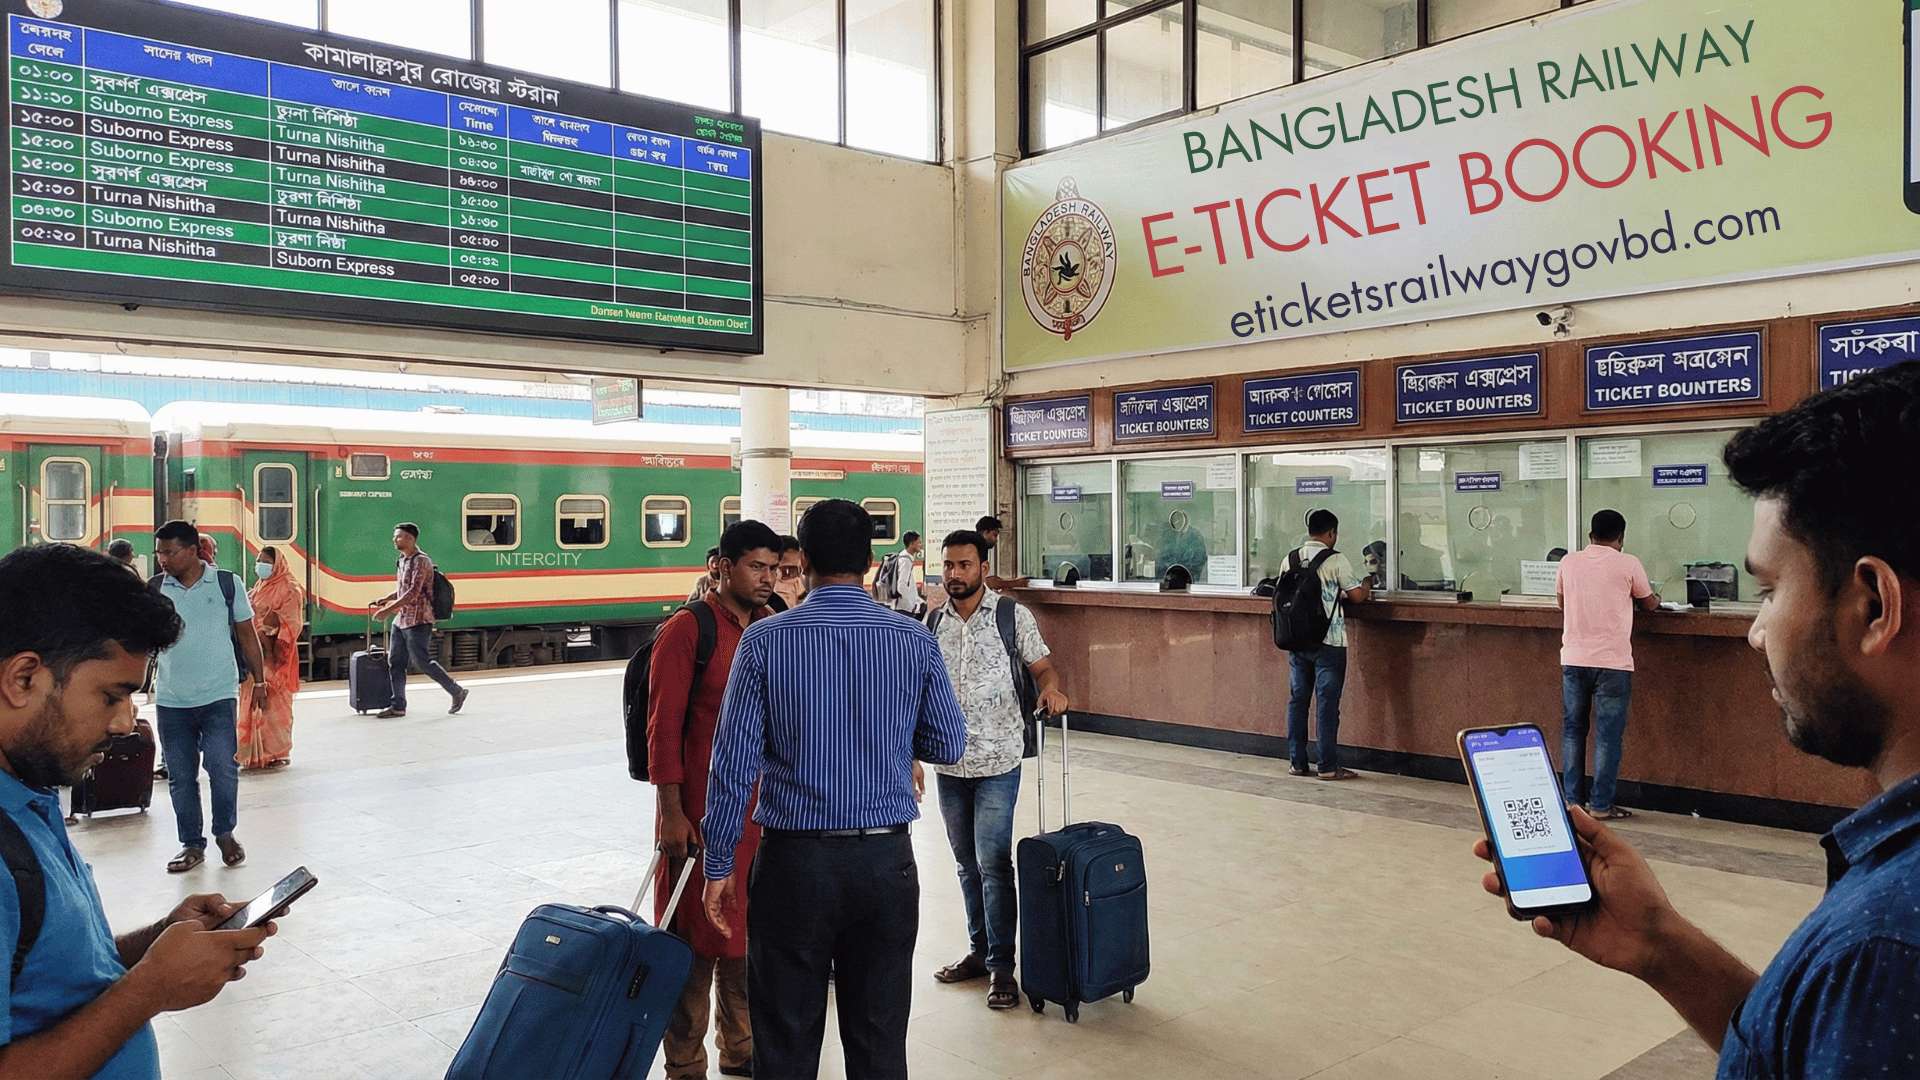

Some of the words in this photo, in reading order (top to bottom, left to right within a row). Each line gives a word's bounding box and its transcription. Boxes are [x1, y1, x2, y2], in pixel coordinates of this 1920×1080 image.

[1183, 67, 1522, 174] BANGLADESH
[1537, 19, 1755, 104] RAILWAY
[90, 96, 163, 121] Suborno
[169, 109, 234, 131] Express
[464, 117, 494, 131] Time
[90, 119, 163, 143] Suborno
[169, 131, 234, 152] Express
[276, 125, 320, 143] Turna
[326, 131, 385, 153] Nishitha
[90, 141, 163, 165] Suborno
[169, 152, 234, 174] Express
[276, 146, 320, 165] Turna
[326, 153, 385, 174] Nishitha
[276, 167, 320, 186] Turna
[326, 173, 385, 194] Nishitha
[1141, 160, 1431, 278] E-TICKET
[1459, 85, 1833, 215] BOOKING
[92, 185, 142, 206] Turna
[148, 193, 216, 214] Nishitha
[92, 209, 163, 230] Suborno
[169, 218, 234, 238] Express
[276, 209, 321, 227] Turna
[326, 214, 385, 234] Nishitha
[92, 231, 142, 250] Turna
[148, 237, 216, 257] Nishitha
[1024, 203, 1076, 277] BANGLADESH
[1081, 204, 1114, 261] RAILWAY
[277, 252, 331, 269] Suborn
[336, 258, 395, 276] Express
[1230, 206, 1781, 338] eticketsrailwaygovbd.com
[1595, 385, 1653, 402] TICKET
[1658, 378, 1752, 397] BOUNTERS
[1249, 412, 1288, 425] TICKET
[1291, 407, 1353, 422] COUNTERS
[1403, 400, 1453, 415] TICKET
[1456, 393, 1533, 412] BOUNTERS
[1010, 431, 1041, 443] TICKET
[1043, 428, 1088, 440] COUNTERS
[1120, 422, 1154, 434] TICKET
[495, 552, 583, 567] INTERCITY
